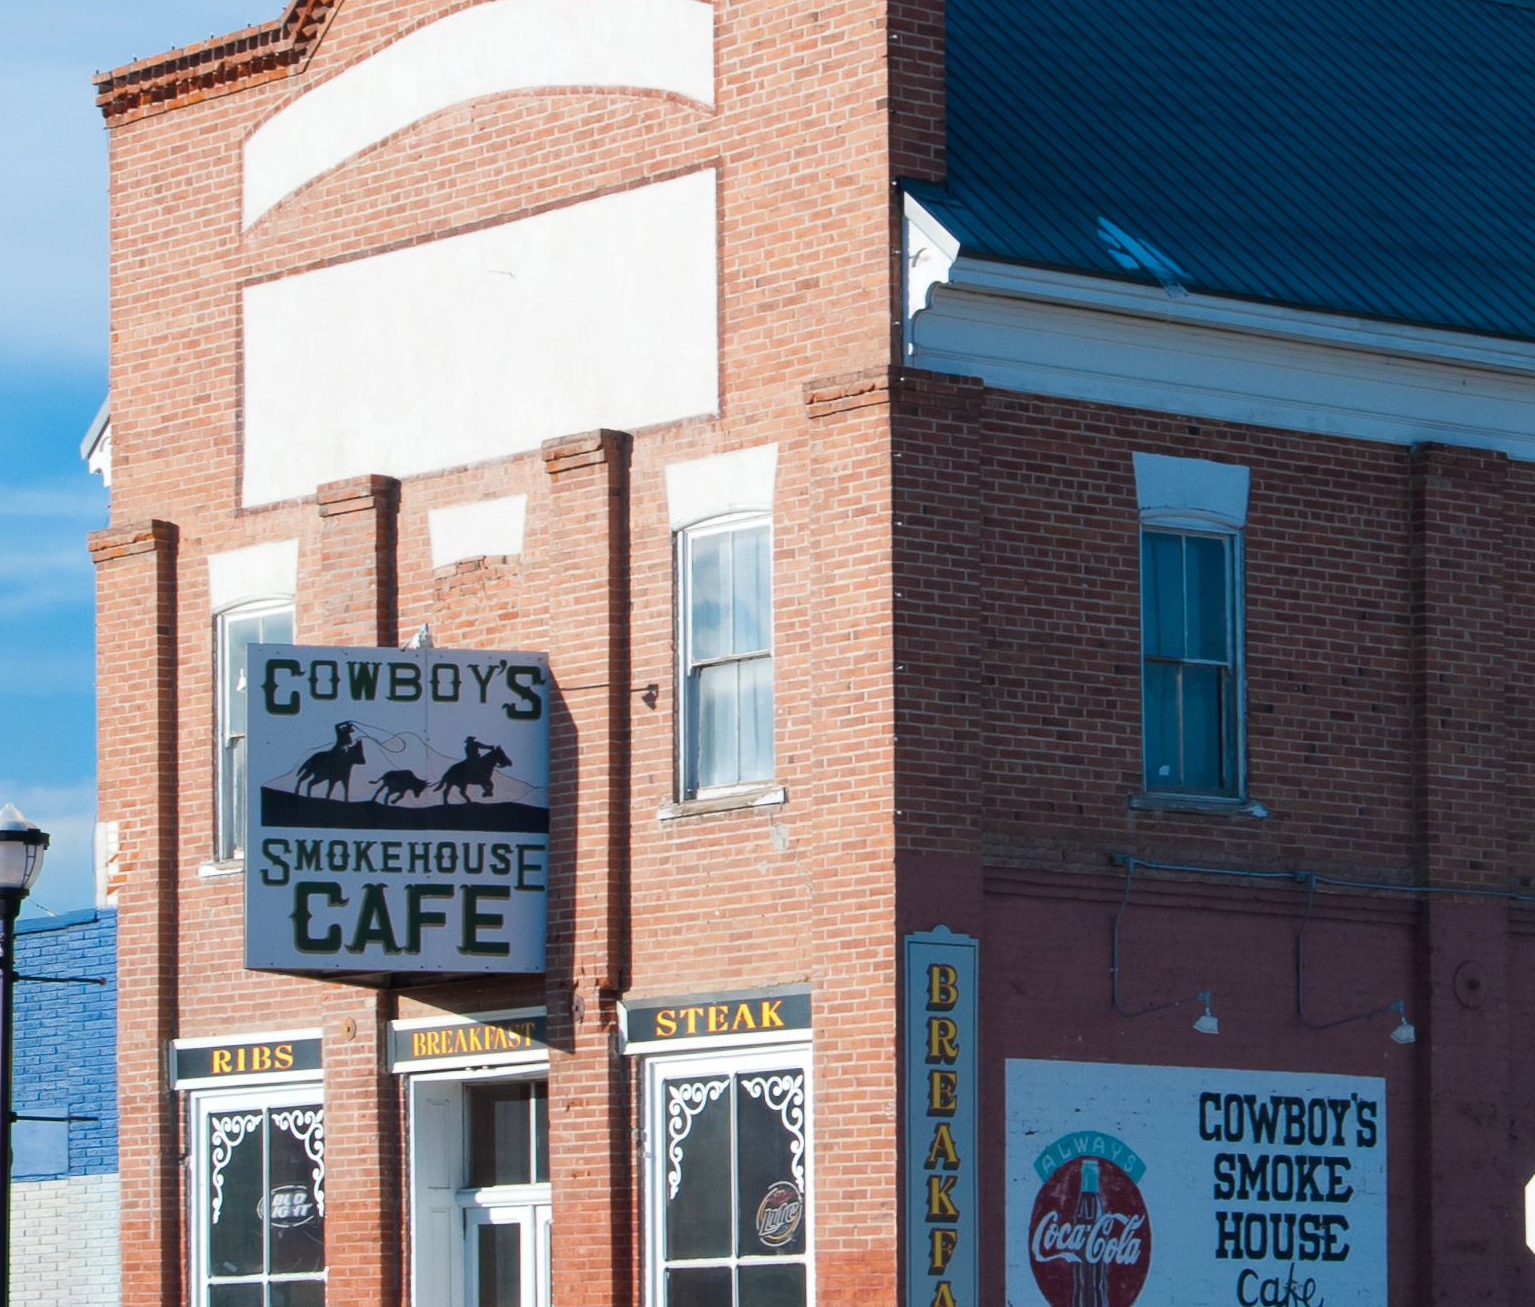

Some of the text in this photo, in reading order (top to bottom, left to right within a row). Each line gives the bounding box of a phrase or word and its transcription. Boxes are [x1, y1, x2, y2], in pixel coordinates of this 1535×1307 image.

[261, 658, 547, 720] COWBOY'S
[259, 837, 546, 892] SMOKEHOUSE
[289, 880, 512, 957] CAFE
[412, 1022, 536, 1058] BREAKFAST
[654, 997, 786, 1037] STEAK
[211, 1044, 294, 1075] RIBS
[1199, 1091, 1378, 1148] COWBOY'S
[1042, 1134, 1138, 1175] ALWAYS
[1213, 1153, 1354, 1203] SMOKE
[1032, 1210, 1146, 1265] Coca-Cola
[1214, 1212, 1351, 1262] HOUSE
